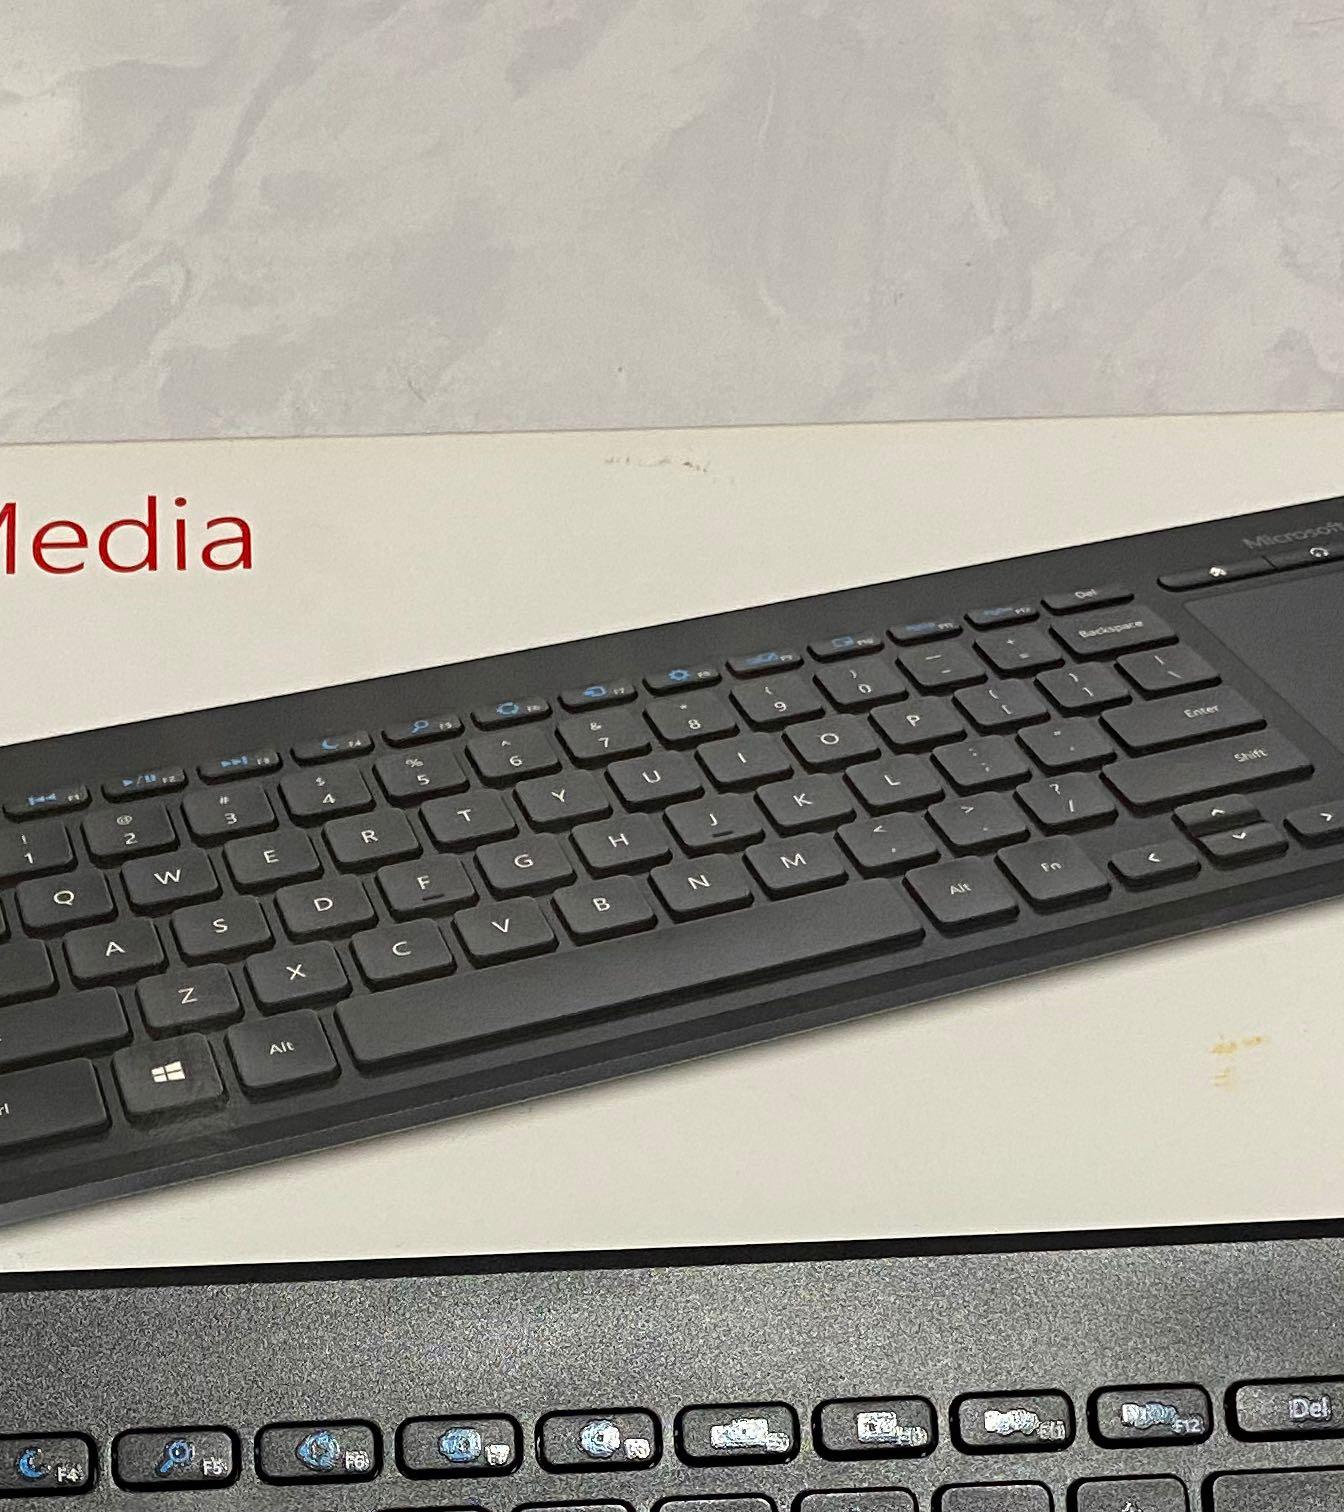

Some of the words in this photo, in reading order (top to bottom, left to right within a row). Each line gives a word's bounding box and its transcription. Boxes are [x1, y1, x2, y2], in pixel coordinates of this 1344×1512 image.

[1078, 619, 1144, 639] Backspace
[774, 701, 788, 712] 9
[1184, 703, 1221, 719] Enter
[688, 719, 701, 730] 8
[906, 714, 921, 726] P
[598, 736, 611, 749] 7
[820, 733, 840, 746] O
[509, 756, 522, 767] 6
[1234, 747, 1269, 763] Shift
[417, 775, 430, 786] 5
[643, 770, 661, 784] U
[884, 775, 901, 786] L
[322, 794, 335, 804] 4
[552, 789, 566, 803] Y
[793, 794, 812, 807] K
[224, 813, 238, 824] 3
[457, 810, 472, 823] T
[707, 813, 719, 827] J
[124, 833, 138, 845] 2
[361, 829, 378, 845] R
[609, 834, 629, 848] H
[25, 853, 34, 863] 1
[264, 849, 279, 864] E
[514, 853, 534, 869] G
[780, 853, 806, 868] M
[1041, 861, 1062, 873] Fn
[154, 869, 182, 885] W
[417, 876, 430, 890] F
[687, 875, 710, 889] N
[949, 882, 971, 896] Alt
[54, 891, 74, 906] Q
[314, 897, 334, 913] D
[593, 897, 610, 912] B
[213, 918, 228, 934] S
[492, 919, 511, 934] V
[105, 942, 125, 956] A
[392, 942, 411, 957] C
[286, 964, 306, 981] X
[178, 987, 198, 1005] Z
[269, 1039, 294, 1055] Alt
[1289, 1398, 1331, 1420] Del
[203, 1460, 226, 1475] F5
[56, 1467, 79, 1483] F4
